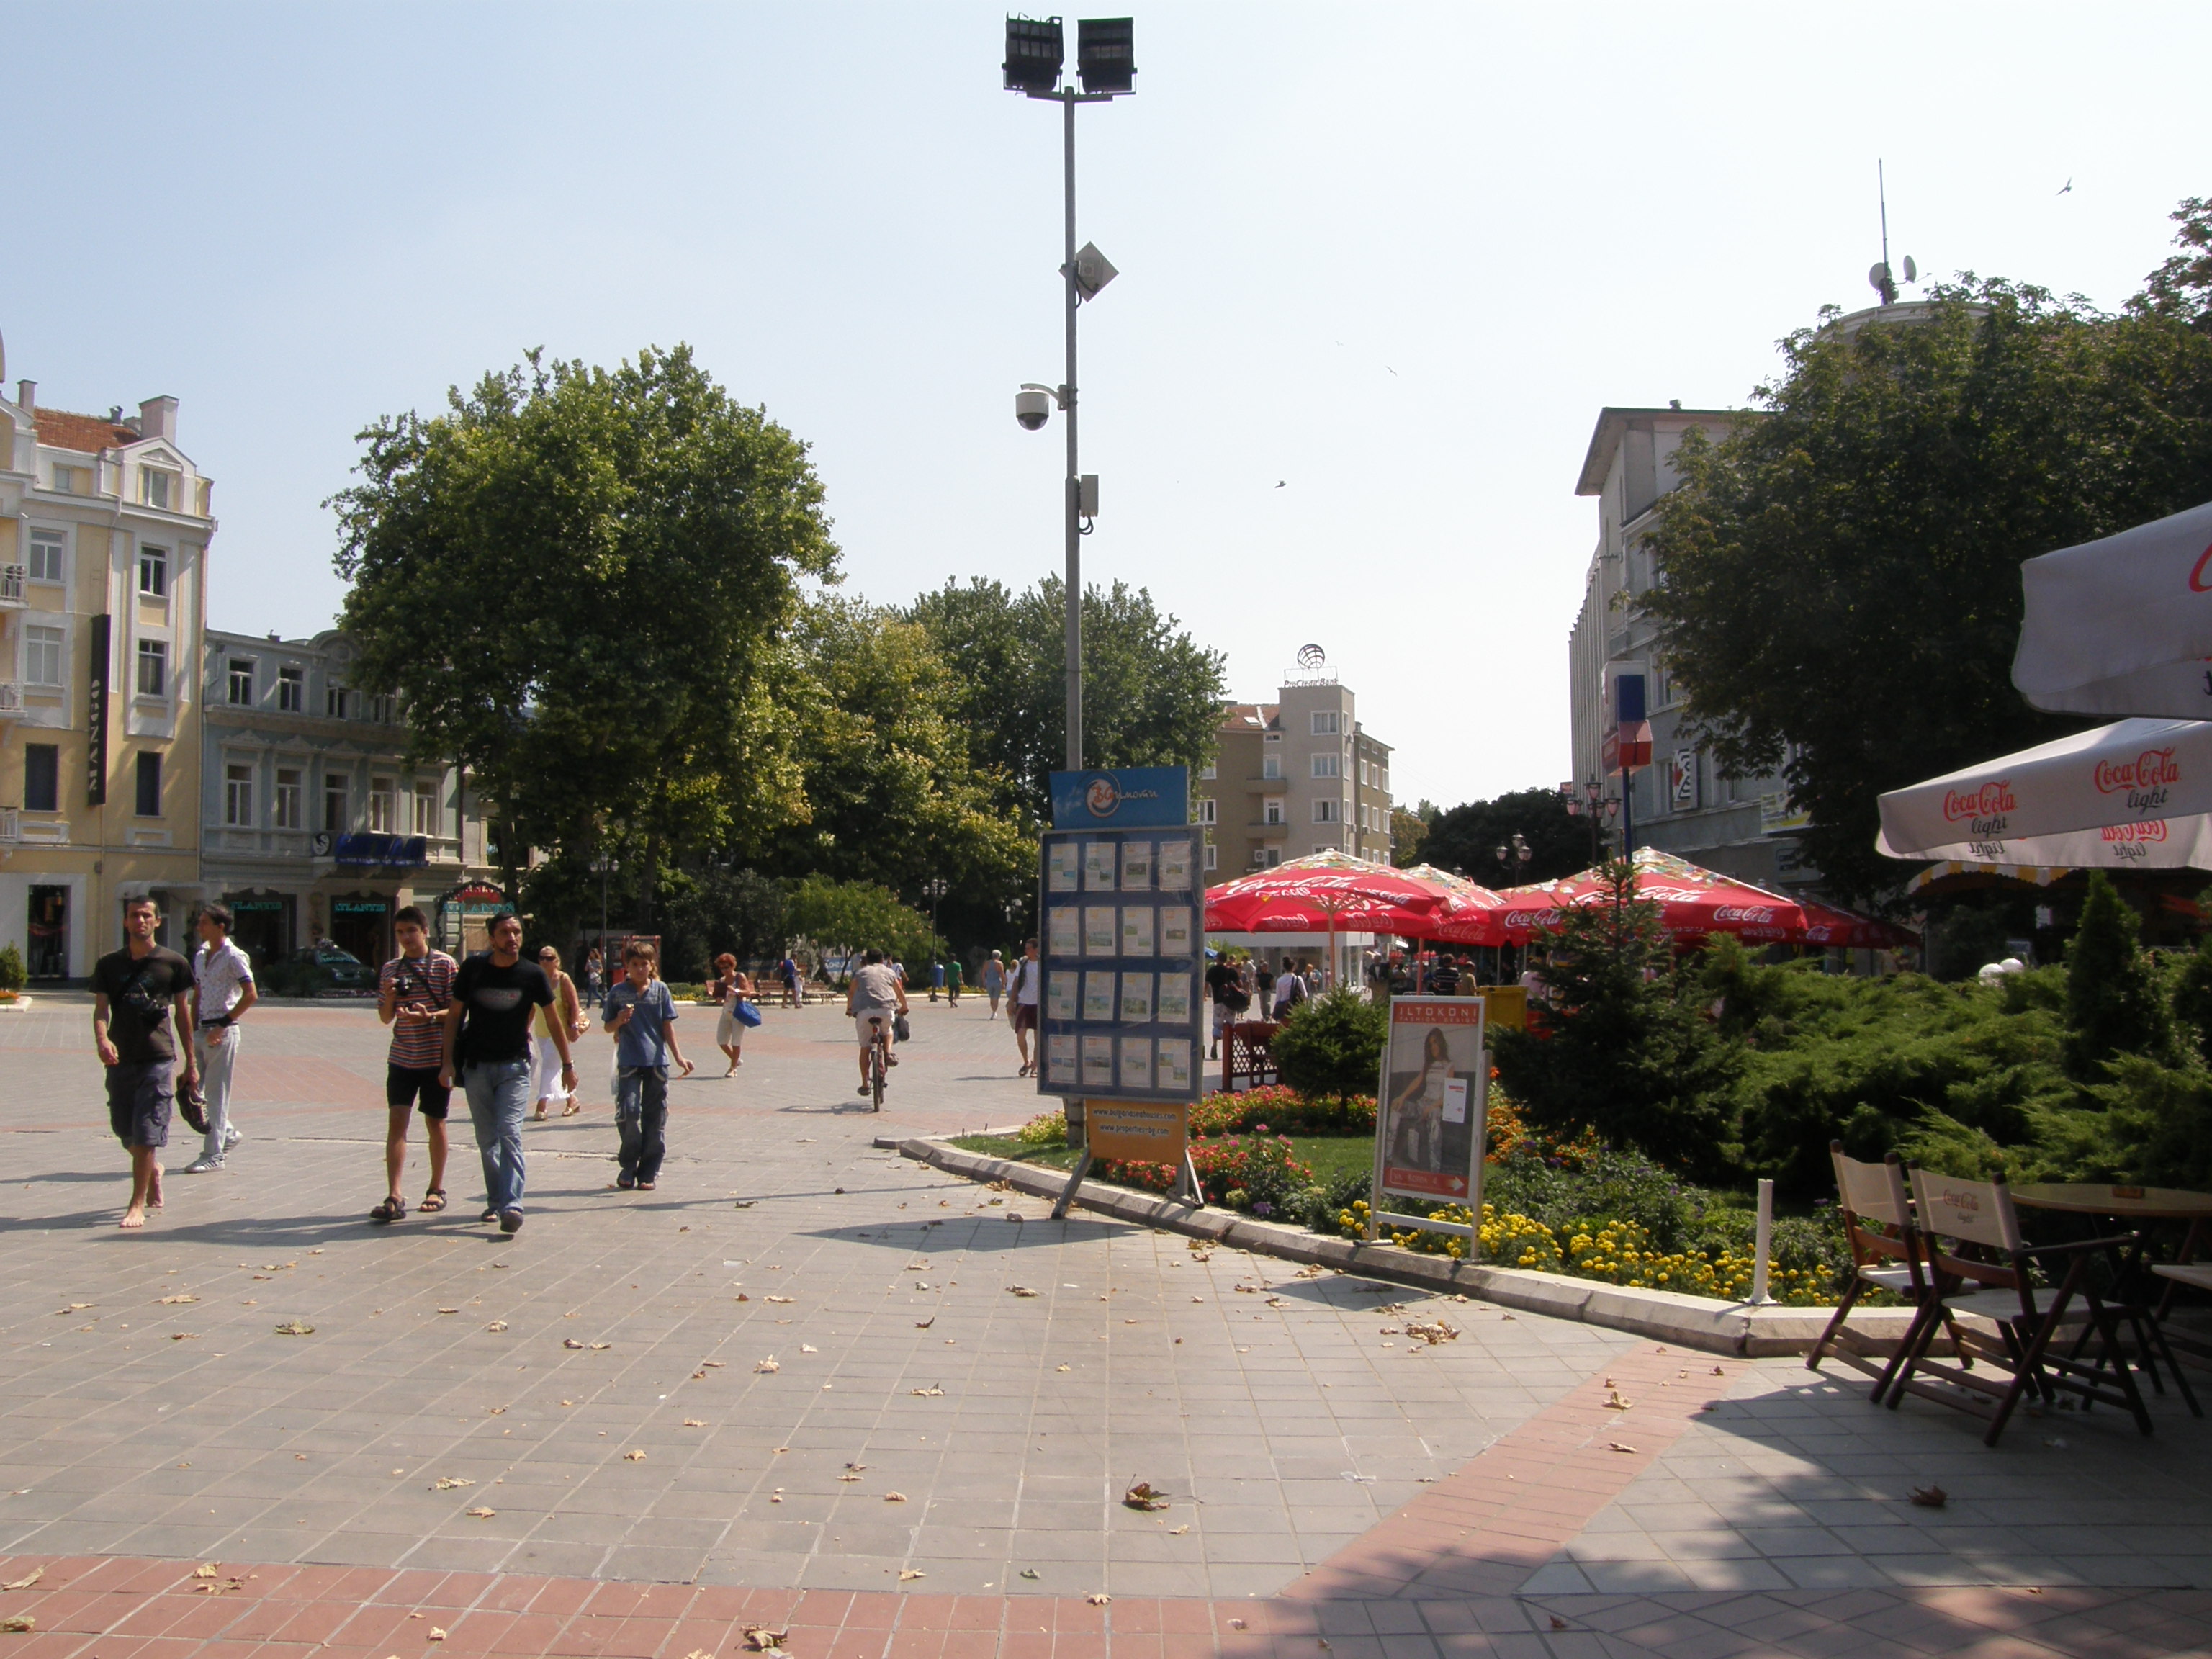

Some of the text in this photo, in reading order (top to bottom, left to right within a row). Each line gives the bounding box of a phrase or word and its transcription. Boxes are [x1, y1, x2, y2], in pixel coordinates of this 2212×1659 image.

[88, 679, 100, 791] MANGO
[2094, 747, 2180, 793] Coca-Cola
[1943, 779, 2018, 822] Coca-Cola
[2127, 786, 2168, 816] light
[1971, 816, 2008, 838] light
[1226, 875, 1368, 895] Coca-Cola
[230, 901, 282, 910] TLANTIS
[1713, 904, 1776, 923] Coca-Cola
[1504, 908, 1563, 928] Coca-Cola
[1399, 1007, 1477, 1017] ILTOKONI
[1943, 1188, 1979, 1211] Coca-Cola
